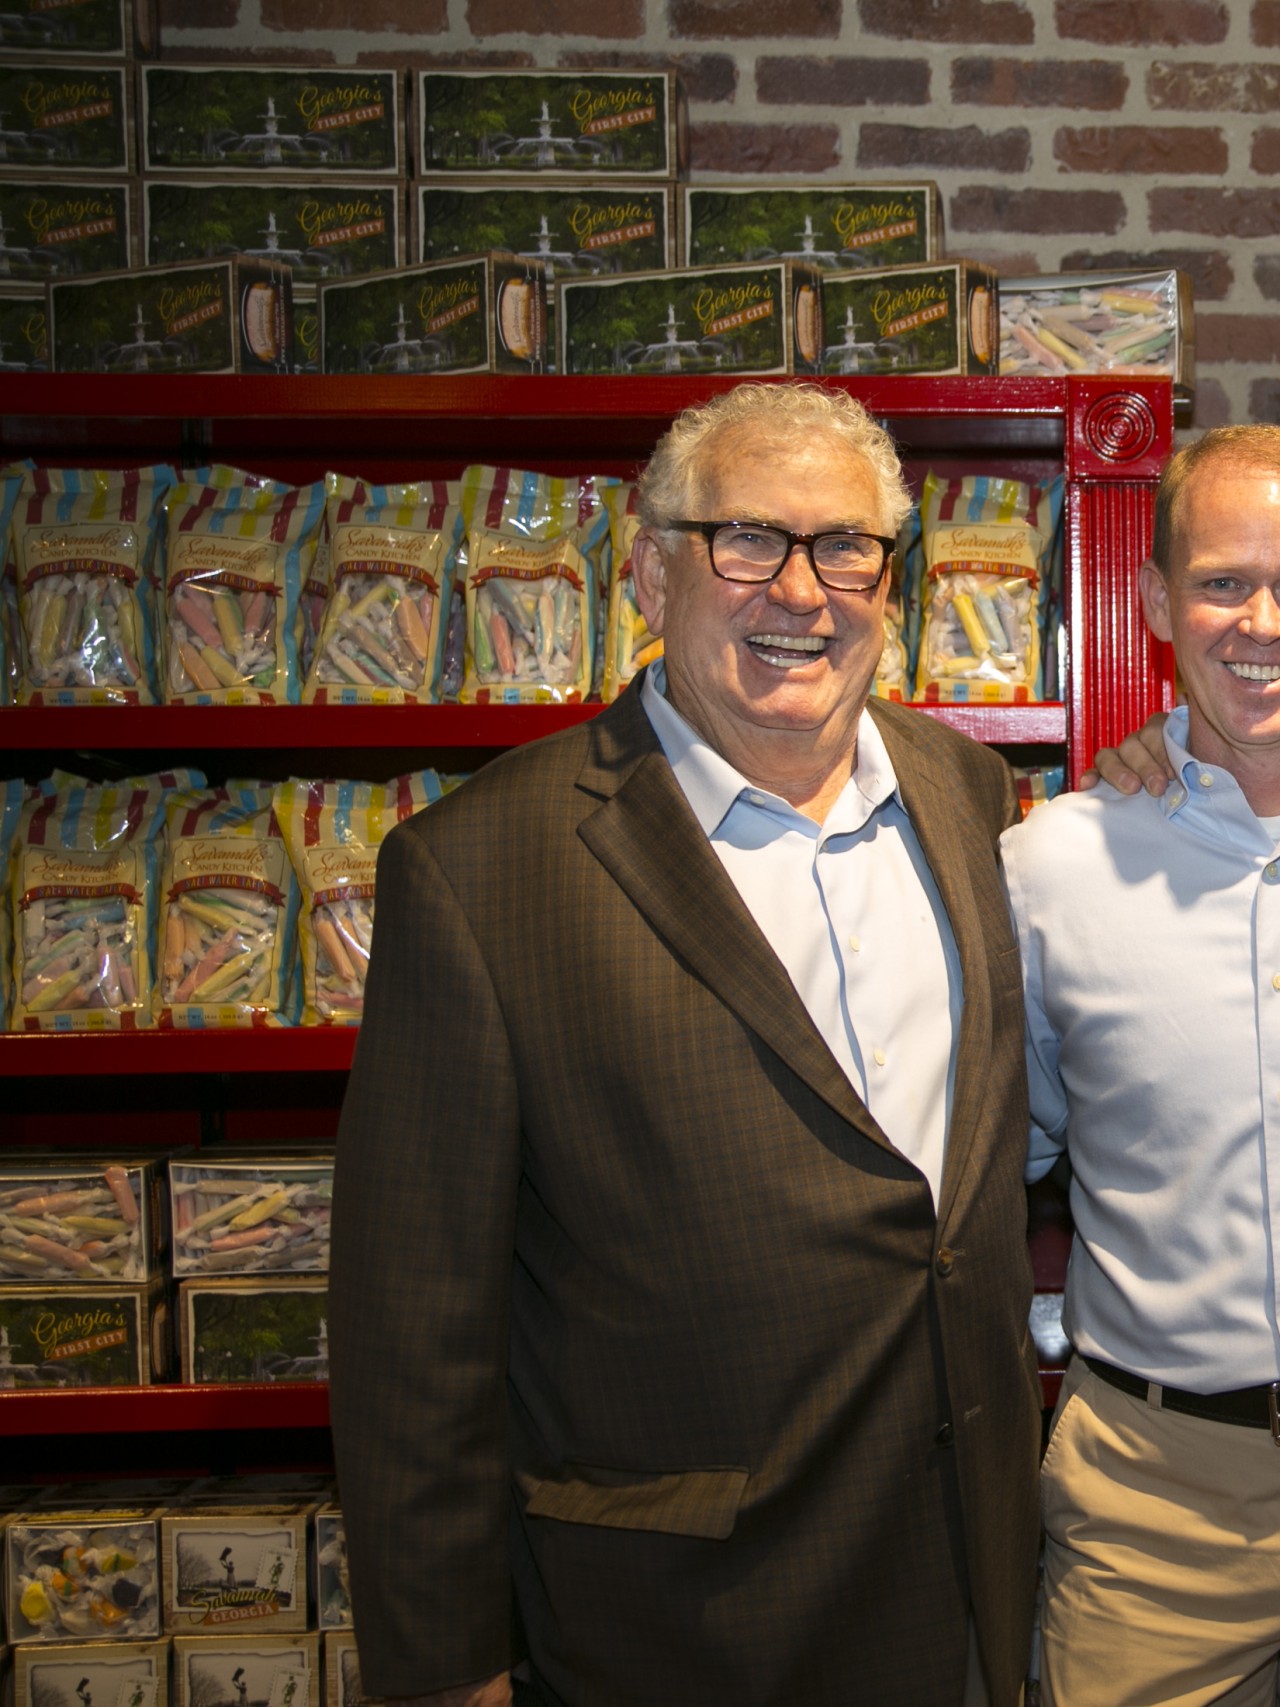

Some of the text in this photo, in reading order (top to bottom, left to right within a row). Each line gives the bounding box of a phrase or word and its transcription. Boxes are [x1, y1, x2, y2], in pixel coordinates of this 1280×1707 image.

[22, 76, 111, 127] Georgia's
[297, 78, 383, 130] Georgia's
[570, 81, 654, 134] Georgia's
[43, 103, 111, 128] FIRST CITY
[318, 105, 383, 131] FIRST CITY
[590, 107, 654, 132] FIRST CITY
[25, 192, 115, 243] Georgia's
[297, 193, 384, 245] Georgia's
[569, 196, 655, 248] Georgia's
[833, 194, 918, 248] Georgia's
[47, 219, 114, 244] FIRST CITY
[319, 221, 383, 245] FIRST CITY
[588, 222, 654, 247] FIRST CITY
[852, 221, 916, 246] FIRST CITY
[157, 272, 223, 335] Georgia's
[418, 269, 479, 333] Georgia's
[694, 274, 773, 334] Georgia's
[872, 276, 948, 336] Georgia's
[172, 302, 222, 333] FIRST CITY
[431, 300, 478, 331] FIRST CITY
[712, 304, 772, 333] FIRST CITY
[889, 305, 947, 335] FIRST CITY
[76, 548, 116, 558] KITCHEN
[941, 528, 1026, 552] Savannah's
[62, 560, 93, 571] WATER
[184, 558, 257, 572] CANDY KITCHEN
[345, 549, 420, 560] CANDY KITCHEN
[950, 549, 1022, 560] CANDY KITCHEN
[342, 562, 425, 577] SALT WATER TAFFY
[946, 561, 1026, 577] SALT WATER TAFFY
[189, 862, 263, 873] CANDY KITCHEN
[38, 887, 62, 898] SALT
[66, 886, 97, 896] WATER
[184, 876, 268, 891] SALT WATER TAFFY
[33, 1302, 126, 1358] Georgia's
[53, 1330, 125, 1359] FIRST CITY
[189, 1585, 278, 1624] Savannah
[212, 1604, 274, 1622] GEORGIA
